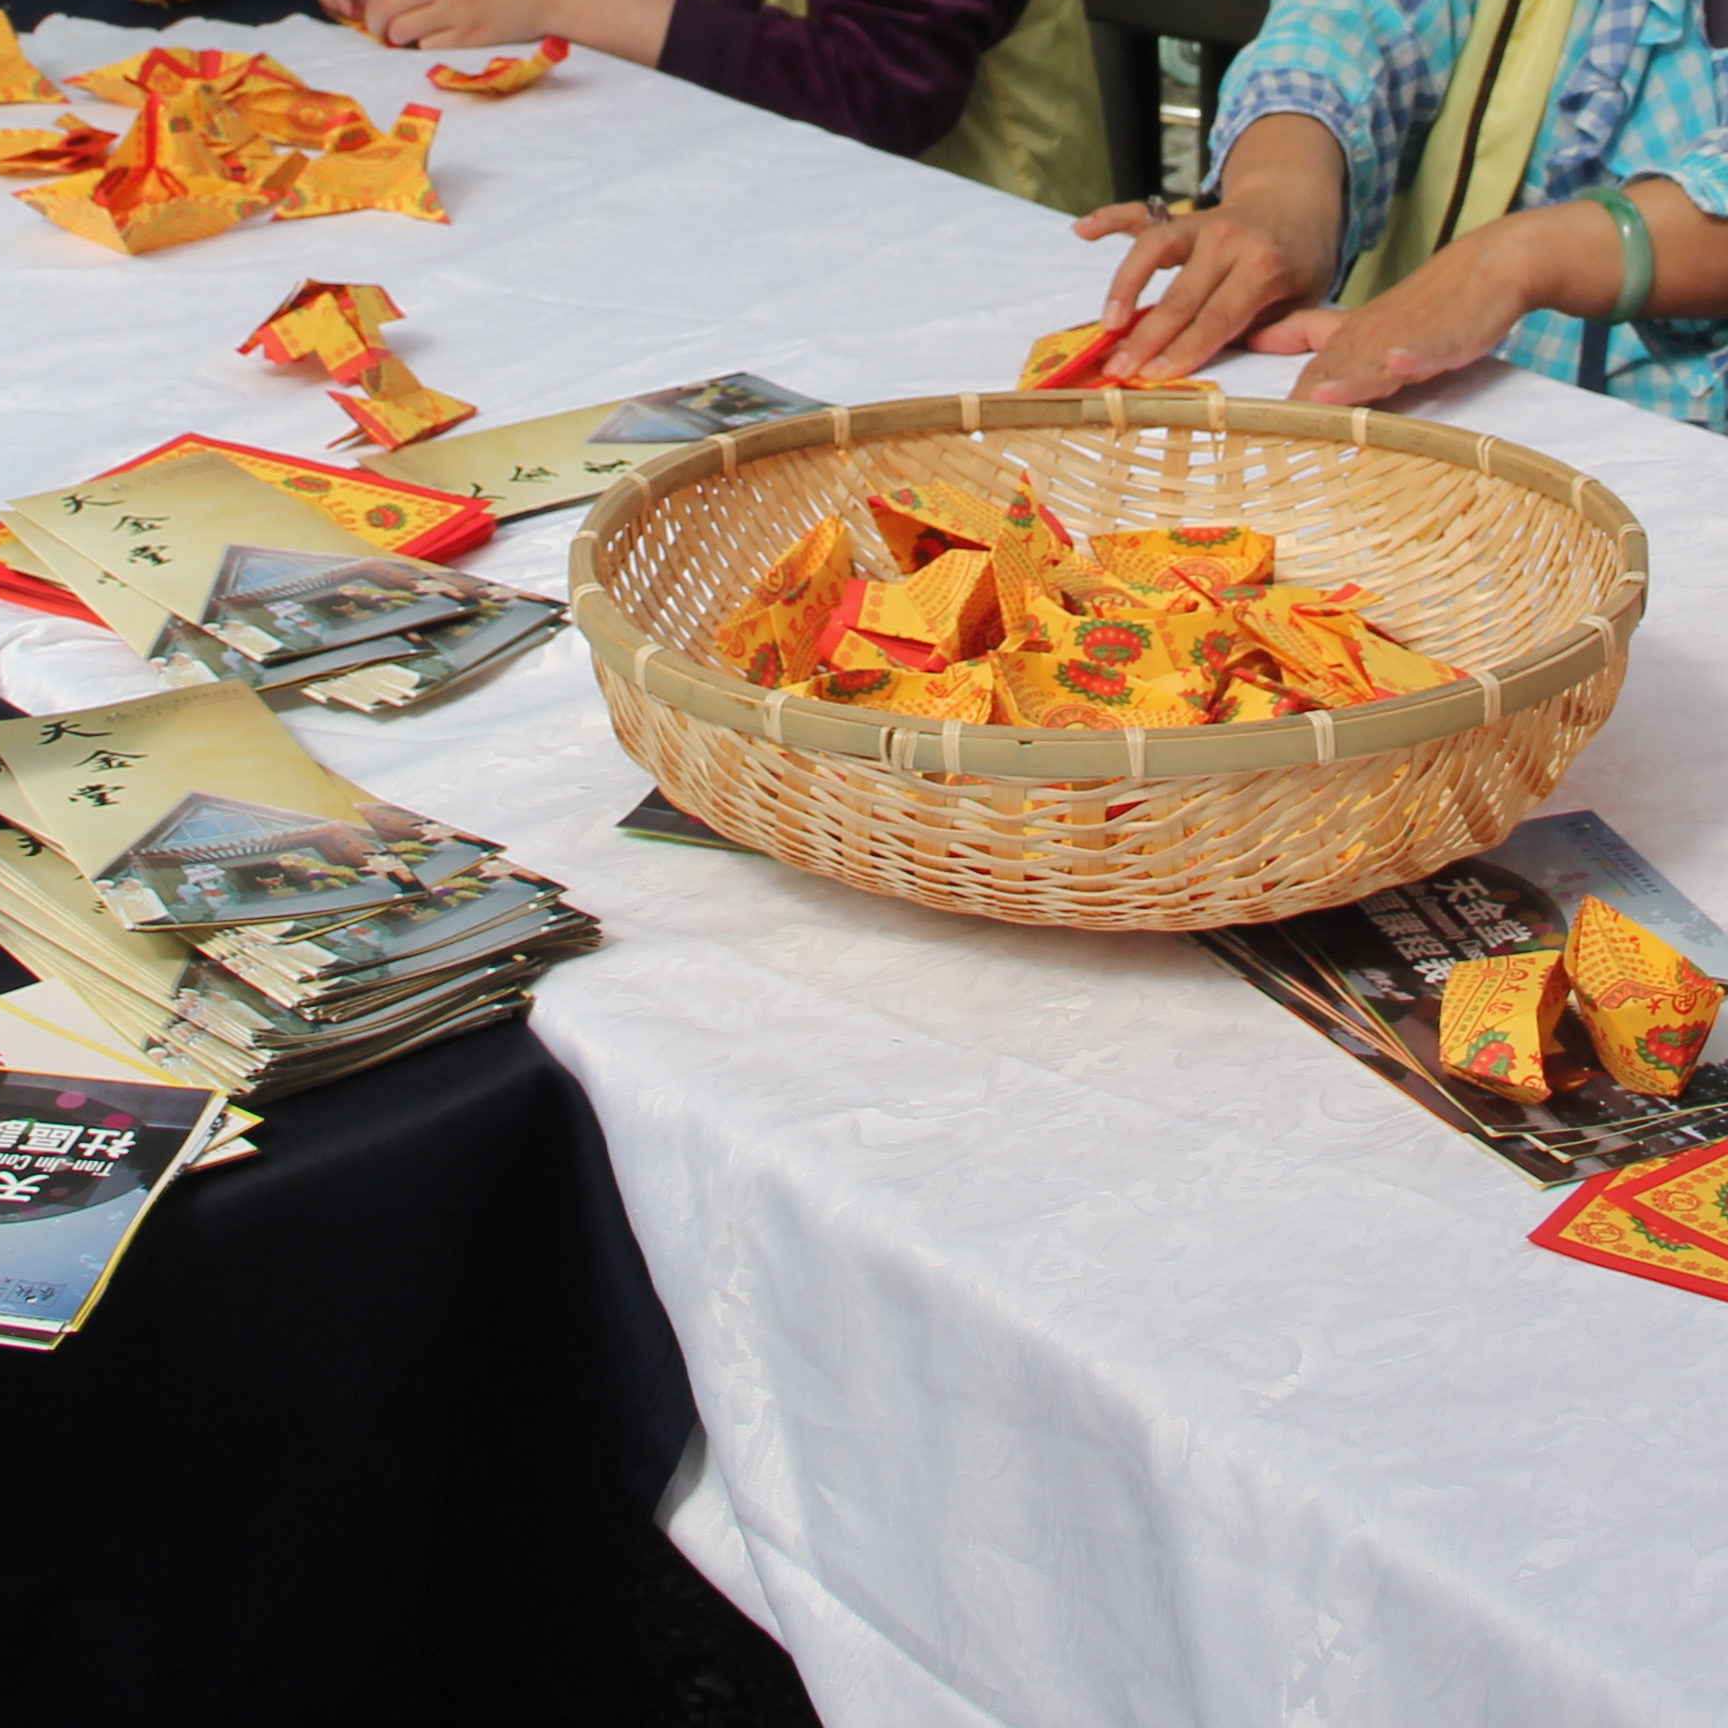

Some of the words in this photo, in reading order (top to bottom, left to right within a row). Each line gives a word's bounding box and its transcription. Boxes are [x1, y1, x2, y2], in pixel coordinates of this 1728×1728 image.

[60, 492, 174, 567] 天金堂
[38, 719, 149, 808] 天金堂
[1433, 877, 1533, 948] 天金堂
[34, 1156, 115, 1177] Tian-Jin
